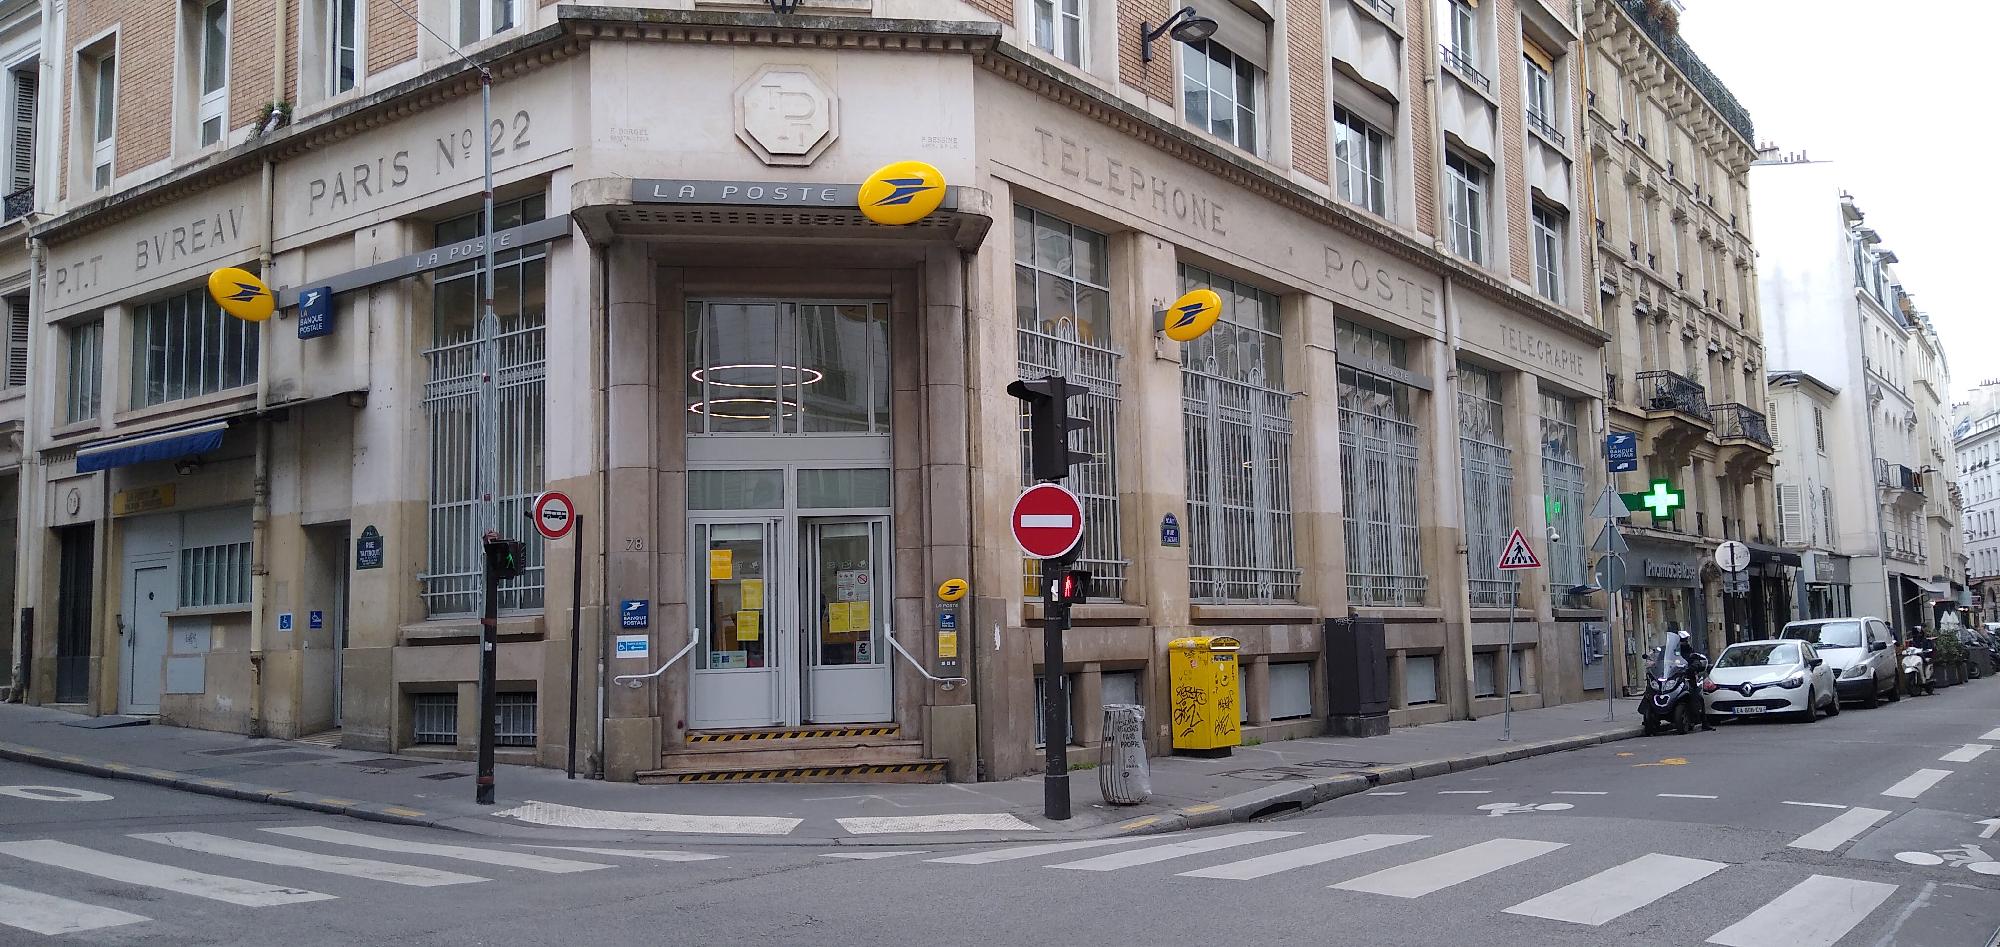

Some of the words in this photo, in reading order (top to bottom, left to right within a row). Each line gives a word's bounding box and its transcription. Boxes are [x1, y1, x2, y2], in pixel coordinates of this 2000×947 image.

[308, 150, 409, 217] PARIS
[488, 109, 531, 158] 22
[653, 184, 696, 198] LA
[721, 185, 838, 201] POSTE
[1035, 127, 1226, 236] TELEPHONE
[134, 205, 244, 272] BVREAV
[415, 253, 438, 268] LA
[1323, 243, 1437, 320] POSTE
[300, 322, 323, 334] POSTALE
[1499, 324, 1584, 377] TELEGRAPHE
[1382, 366, 1409, 380] POSTE
[625, 538, 644, 551] 78
